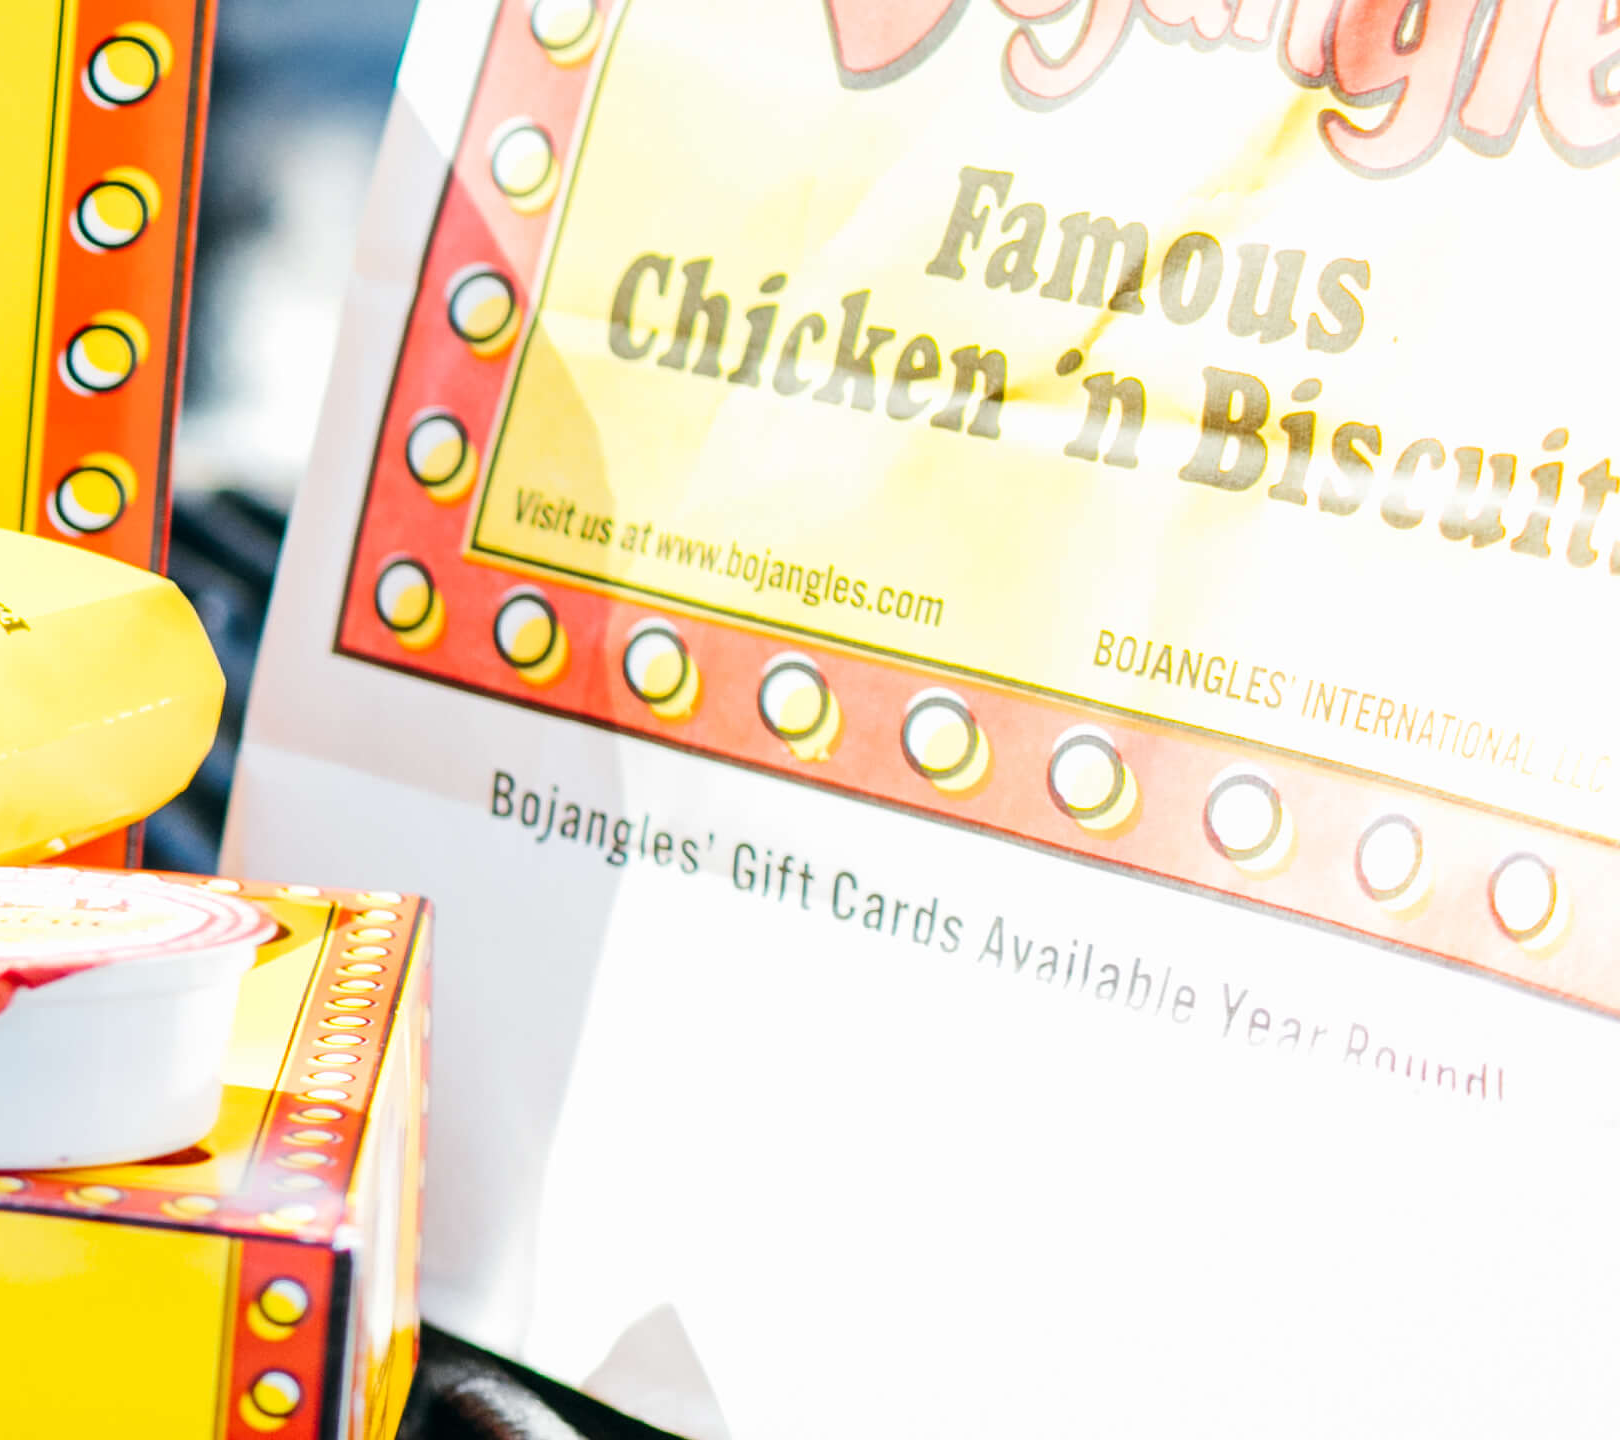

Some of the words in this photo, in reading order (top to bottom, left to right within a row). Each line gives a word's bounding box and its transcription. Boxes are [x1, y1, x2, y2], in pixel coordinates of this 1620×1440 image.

[926, 164, 1371, 355] Famous
[608, 252, 1008, 441] Chicken
[1177, 365, 1619, 575] Biscuit
[515, 488, 576, 537] Visit
[581, 517, 614, 546] us
[621, 522, 653, 554] at
[656, 530, 945, 628] www.bojangles.com
[1093, 629, 1296, 710] BOJANGLES'
[1302, 679, 1536, 777] INTERNATIONAL
[490, 770, 715, 874] Bojangles'
[732, 841, 815, 910] Gift
[832, 871, 964, 955] Cards
[977, 915, 1196, 1024] Available
[1223, 982, 1328, 1050] Year
